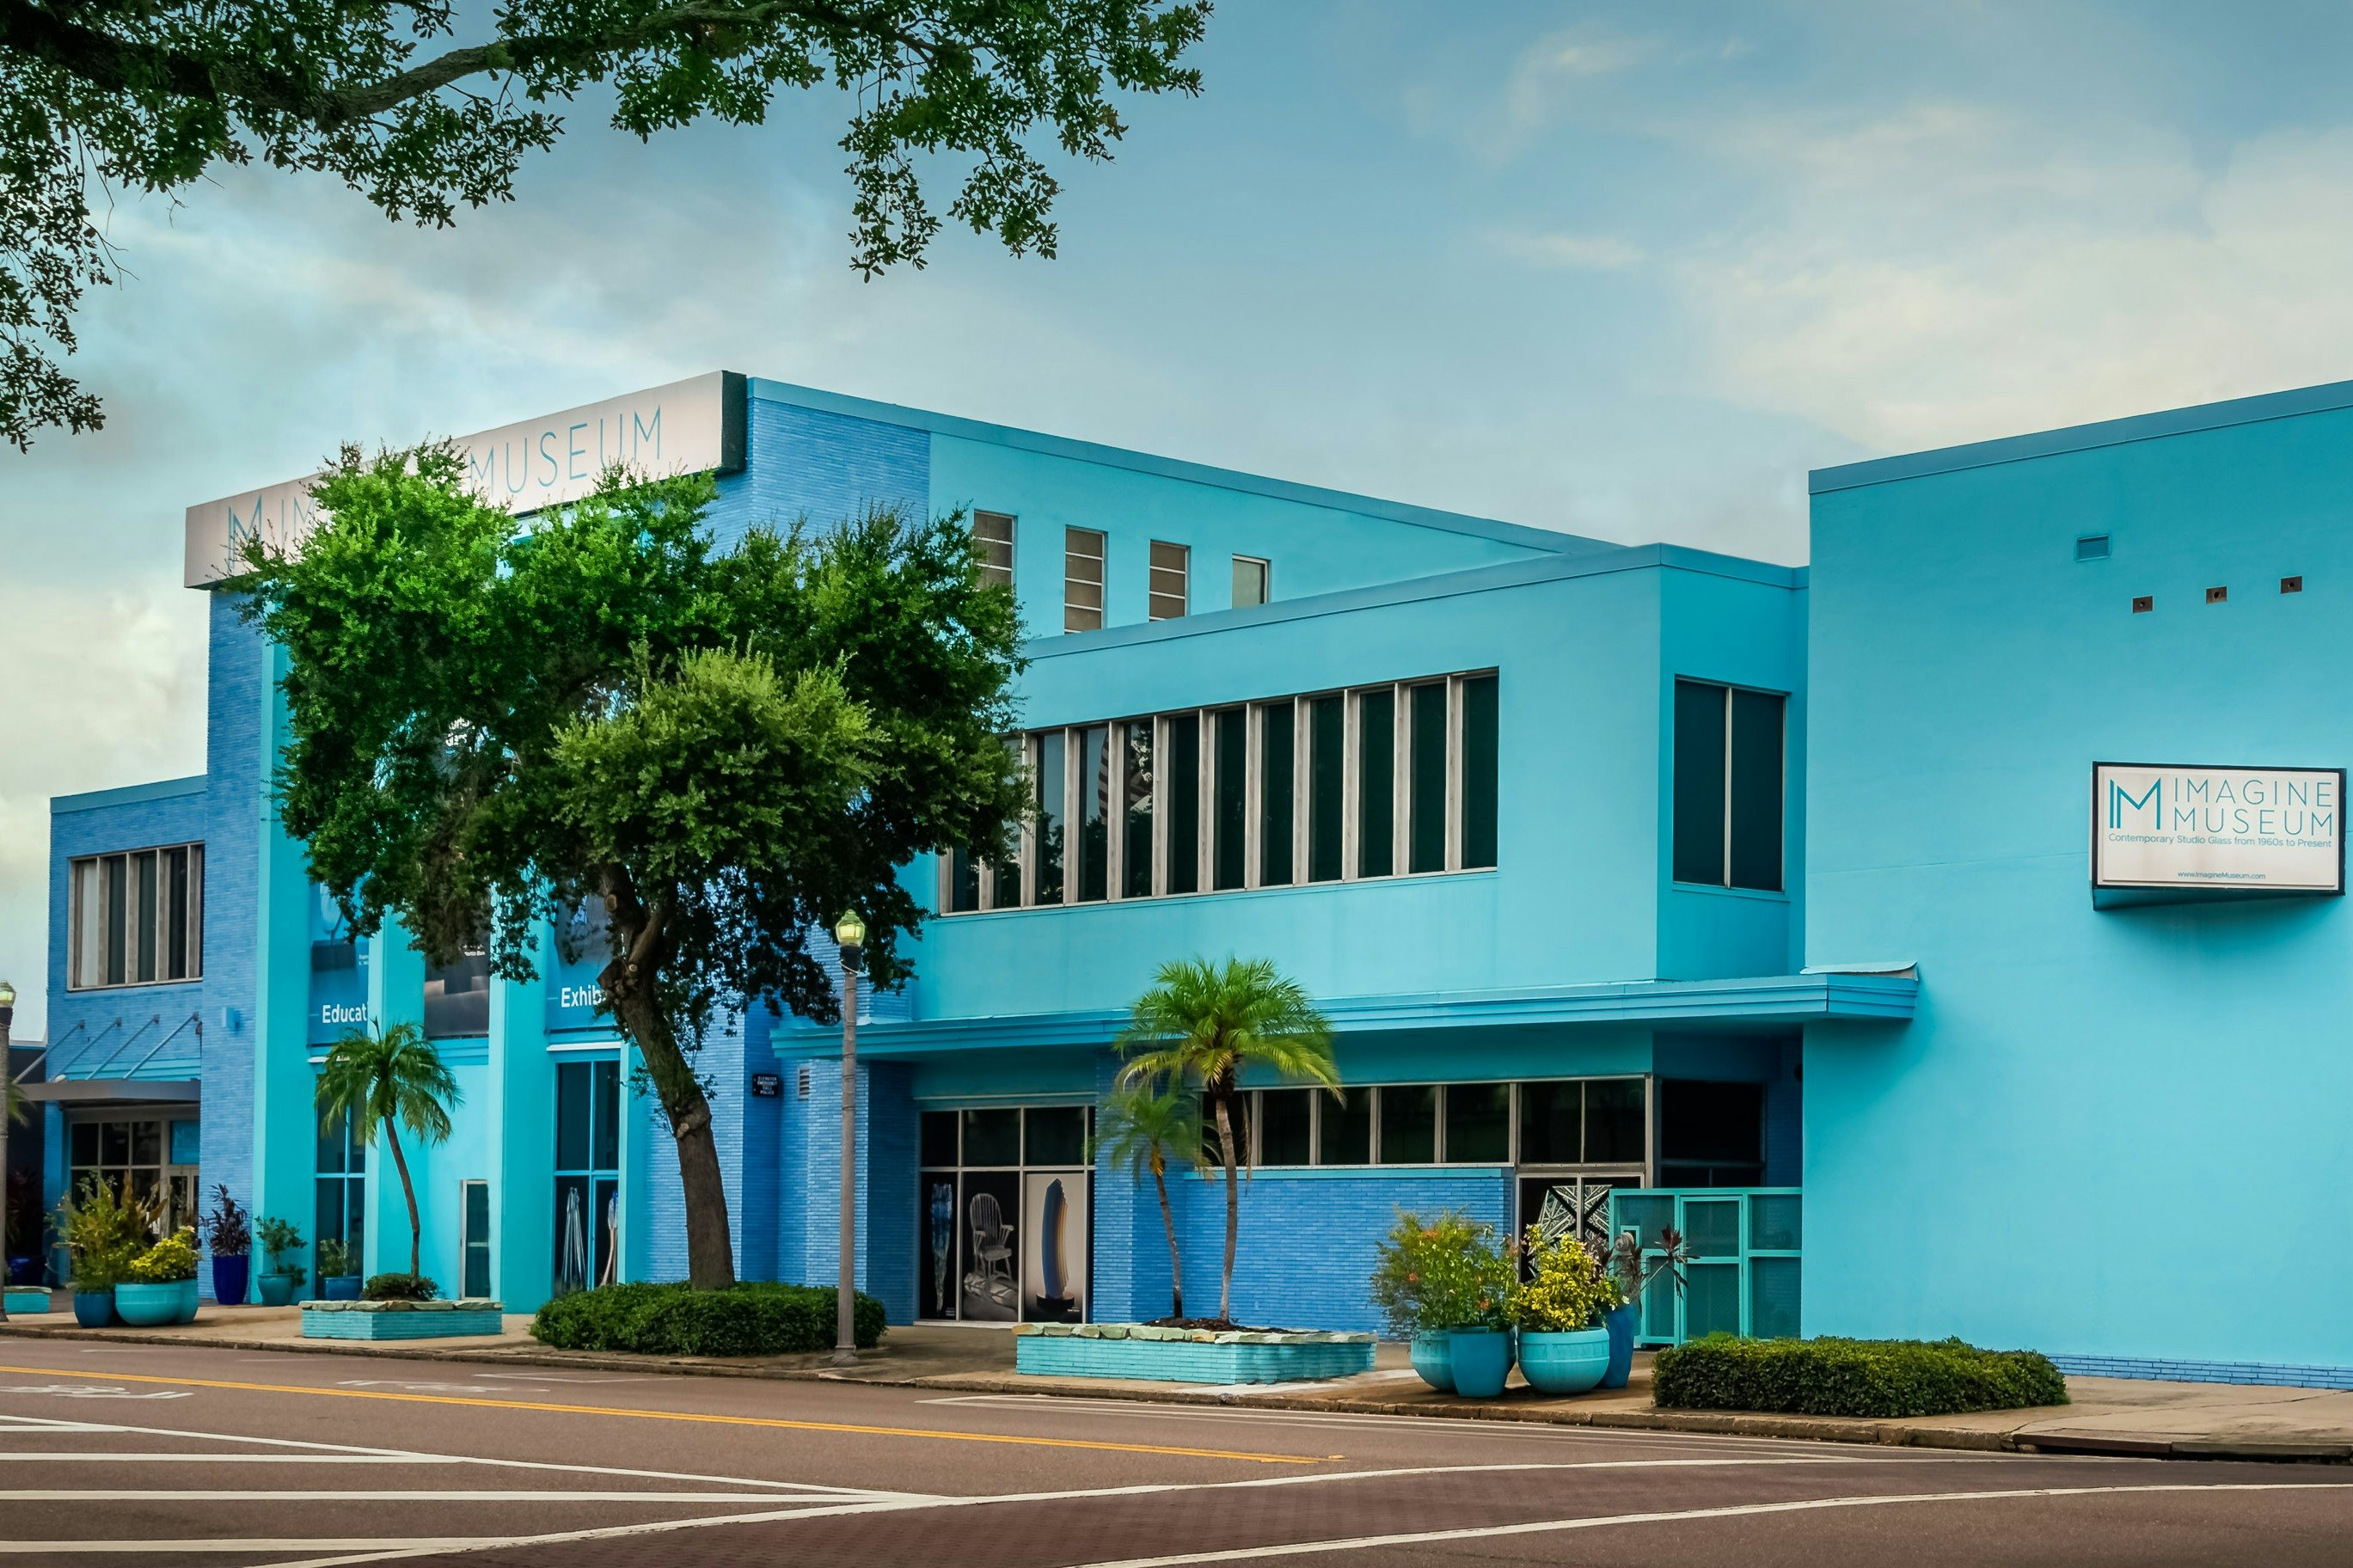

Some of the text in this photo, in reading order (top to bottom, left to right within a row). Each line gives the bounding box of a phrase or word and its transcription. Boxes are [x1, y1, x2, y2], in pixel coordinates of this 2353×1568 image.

[469, 405, 661, 497] MUSEUM
[2174, 777, 2332, 807] IMAGINE
[2174, 806, 2332, 836] MUSEUM
[2108, 833, 2332, 848] Contemporary Studio Glass from 1960s to Present
[561, 984, 607, 1008] Exhib
[322, 1004, 367, 1023] Educat
